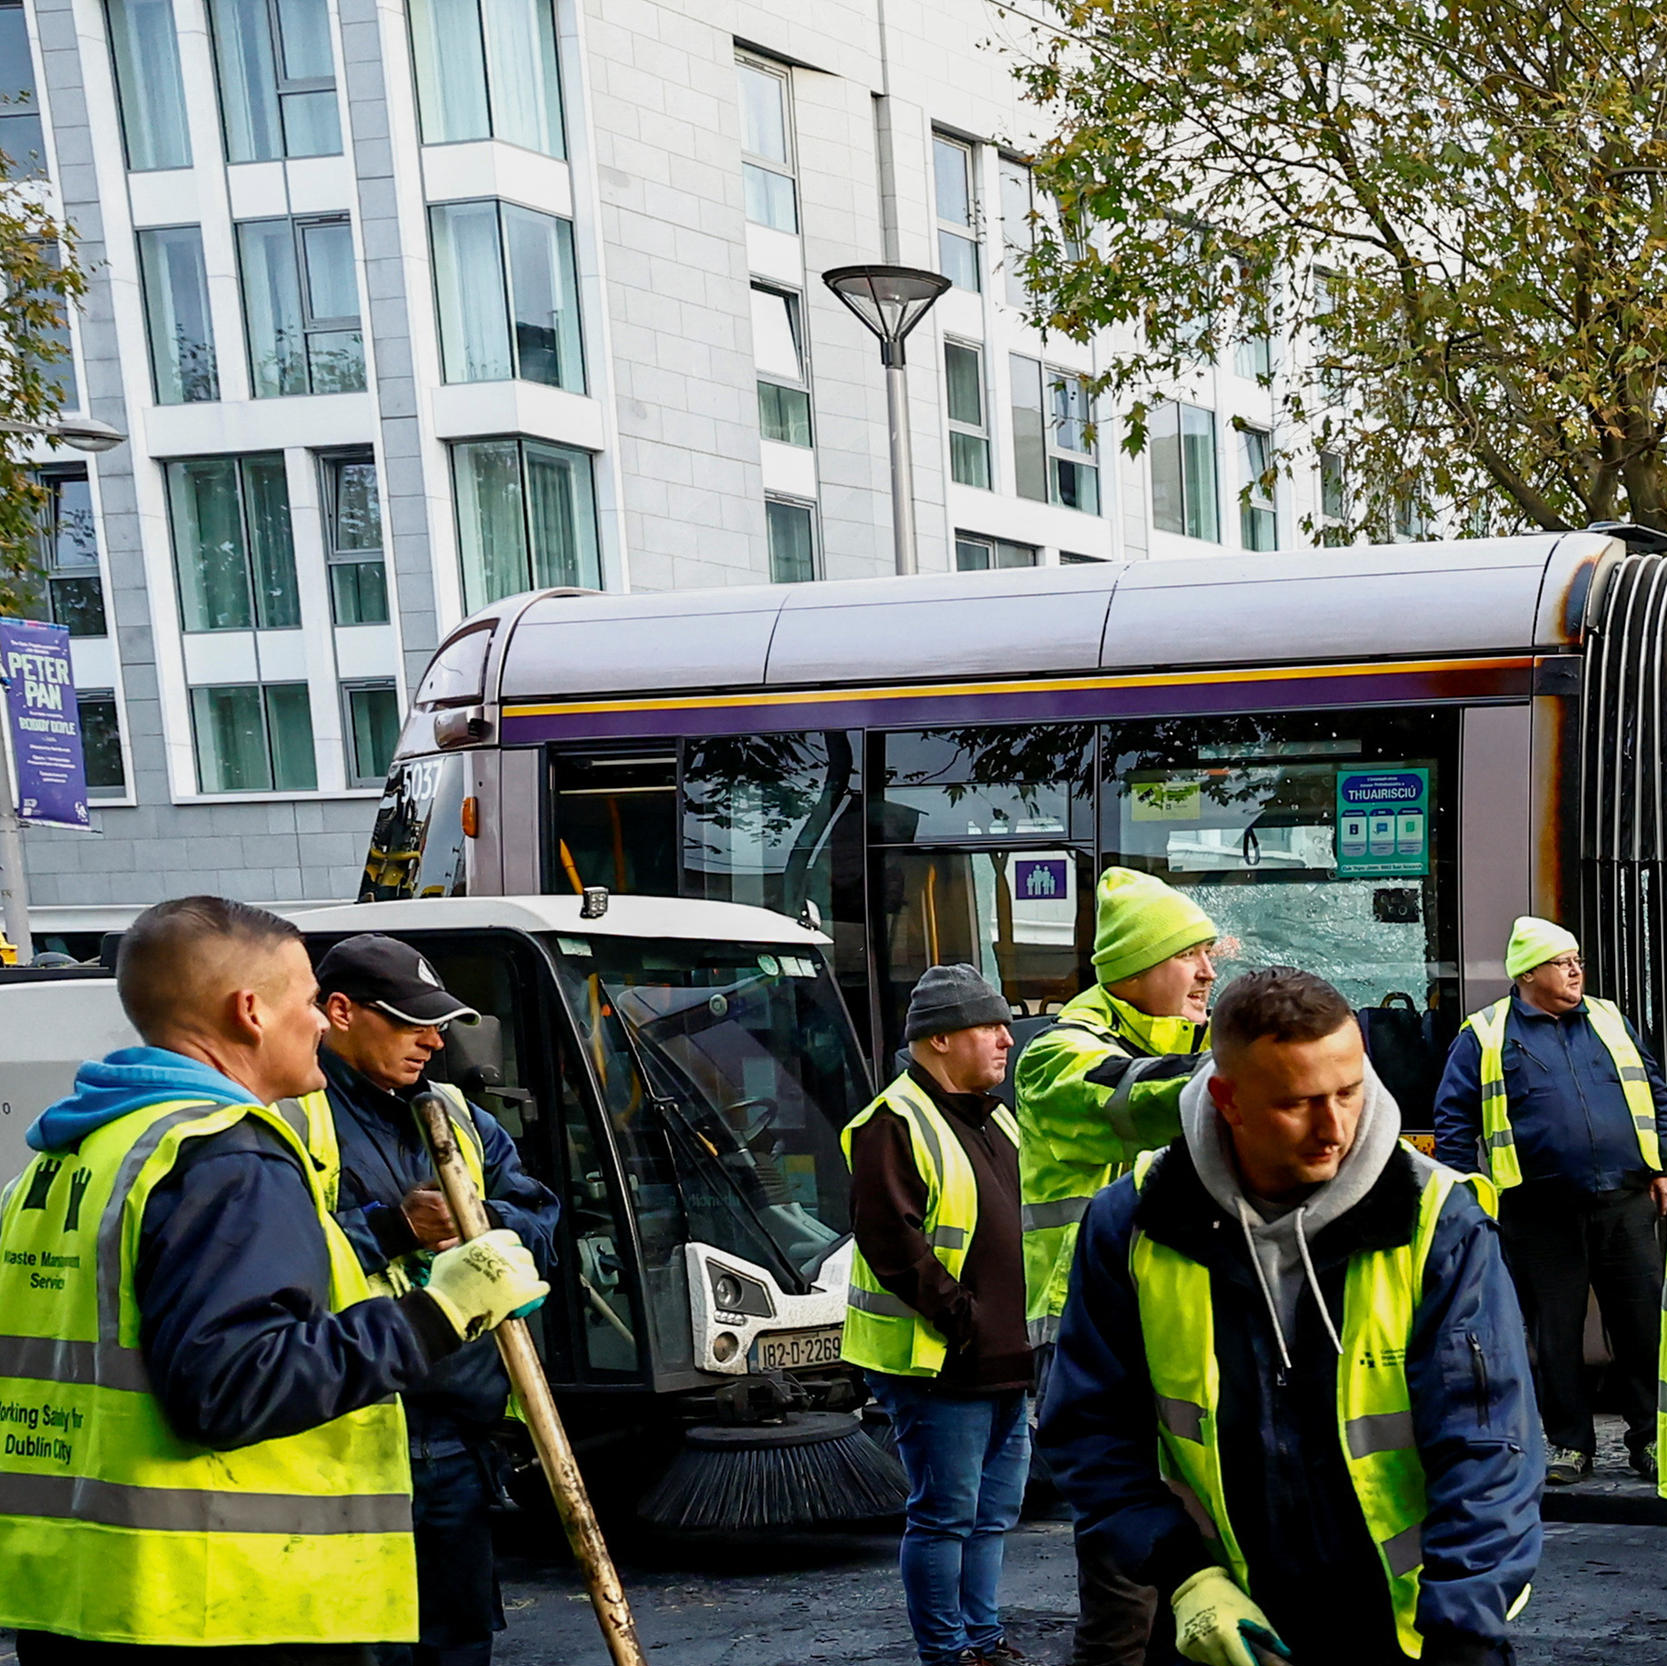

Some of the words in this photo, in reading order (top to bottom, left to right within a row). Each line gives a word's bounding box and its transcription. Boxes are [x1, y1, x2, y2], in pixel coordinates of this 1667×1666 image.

[7, 652, 70, 685] PETER
[24, 680, 63, 711] PAN
[1347, 784, 1417, 801] THUAIRISCIÚ
[763, 1336, 840, 1367] 182-D-2269
[5, 1433, 52, 1458] Dublin
